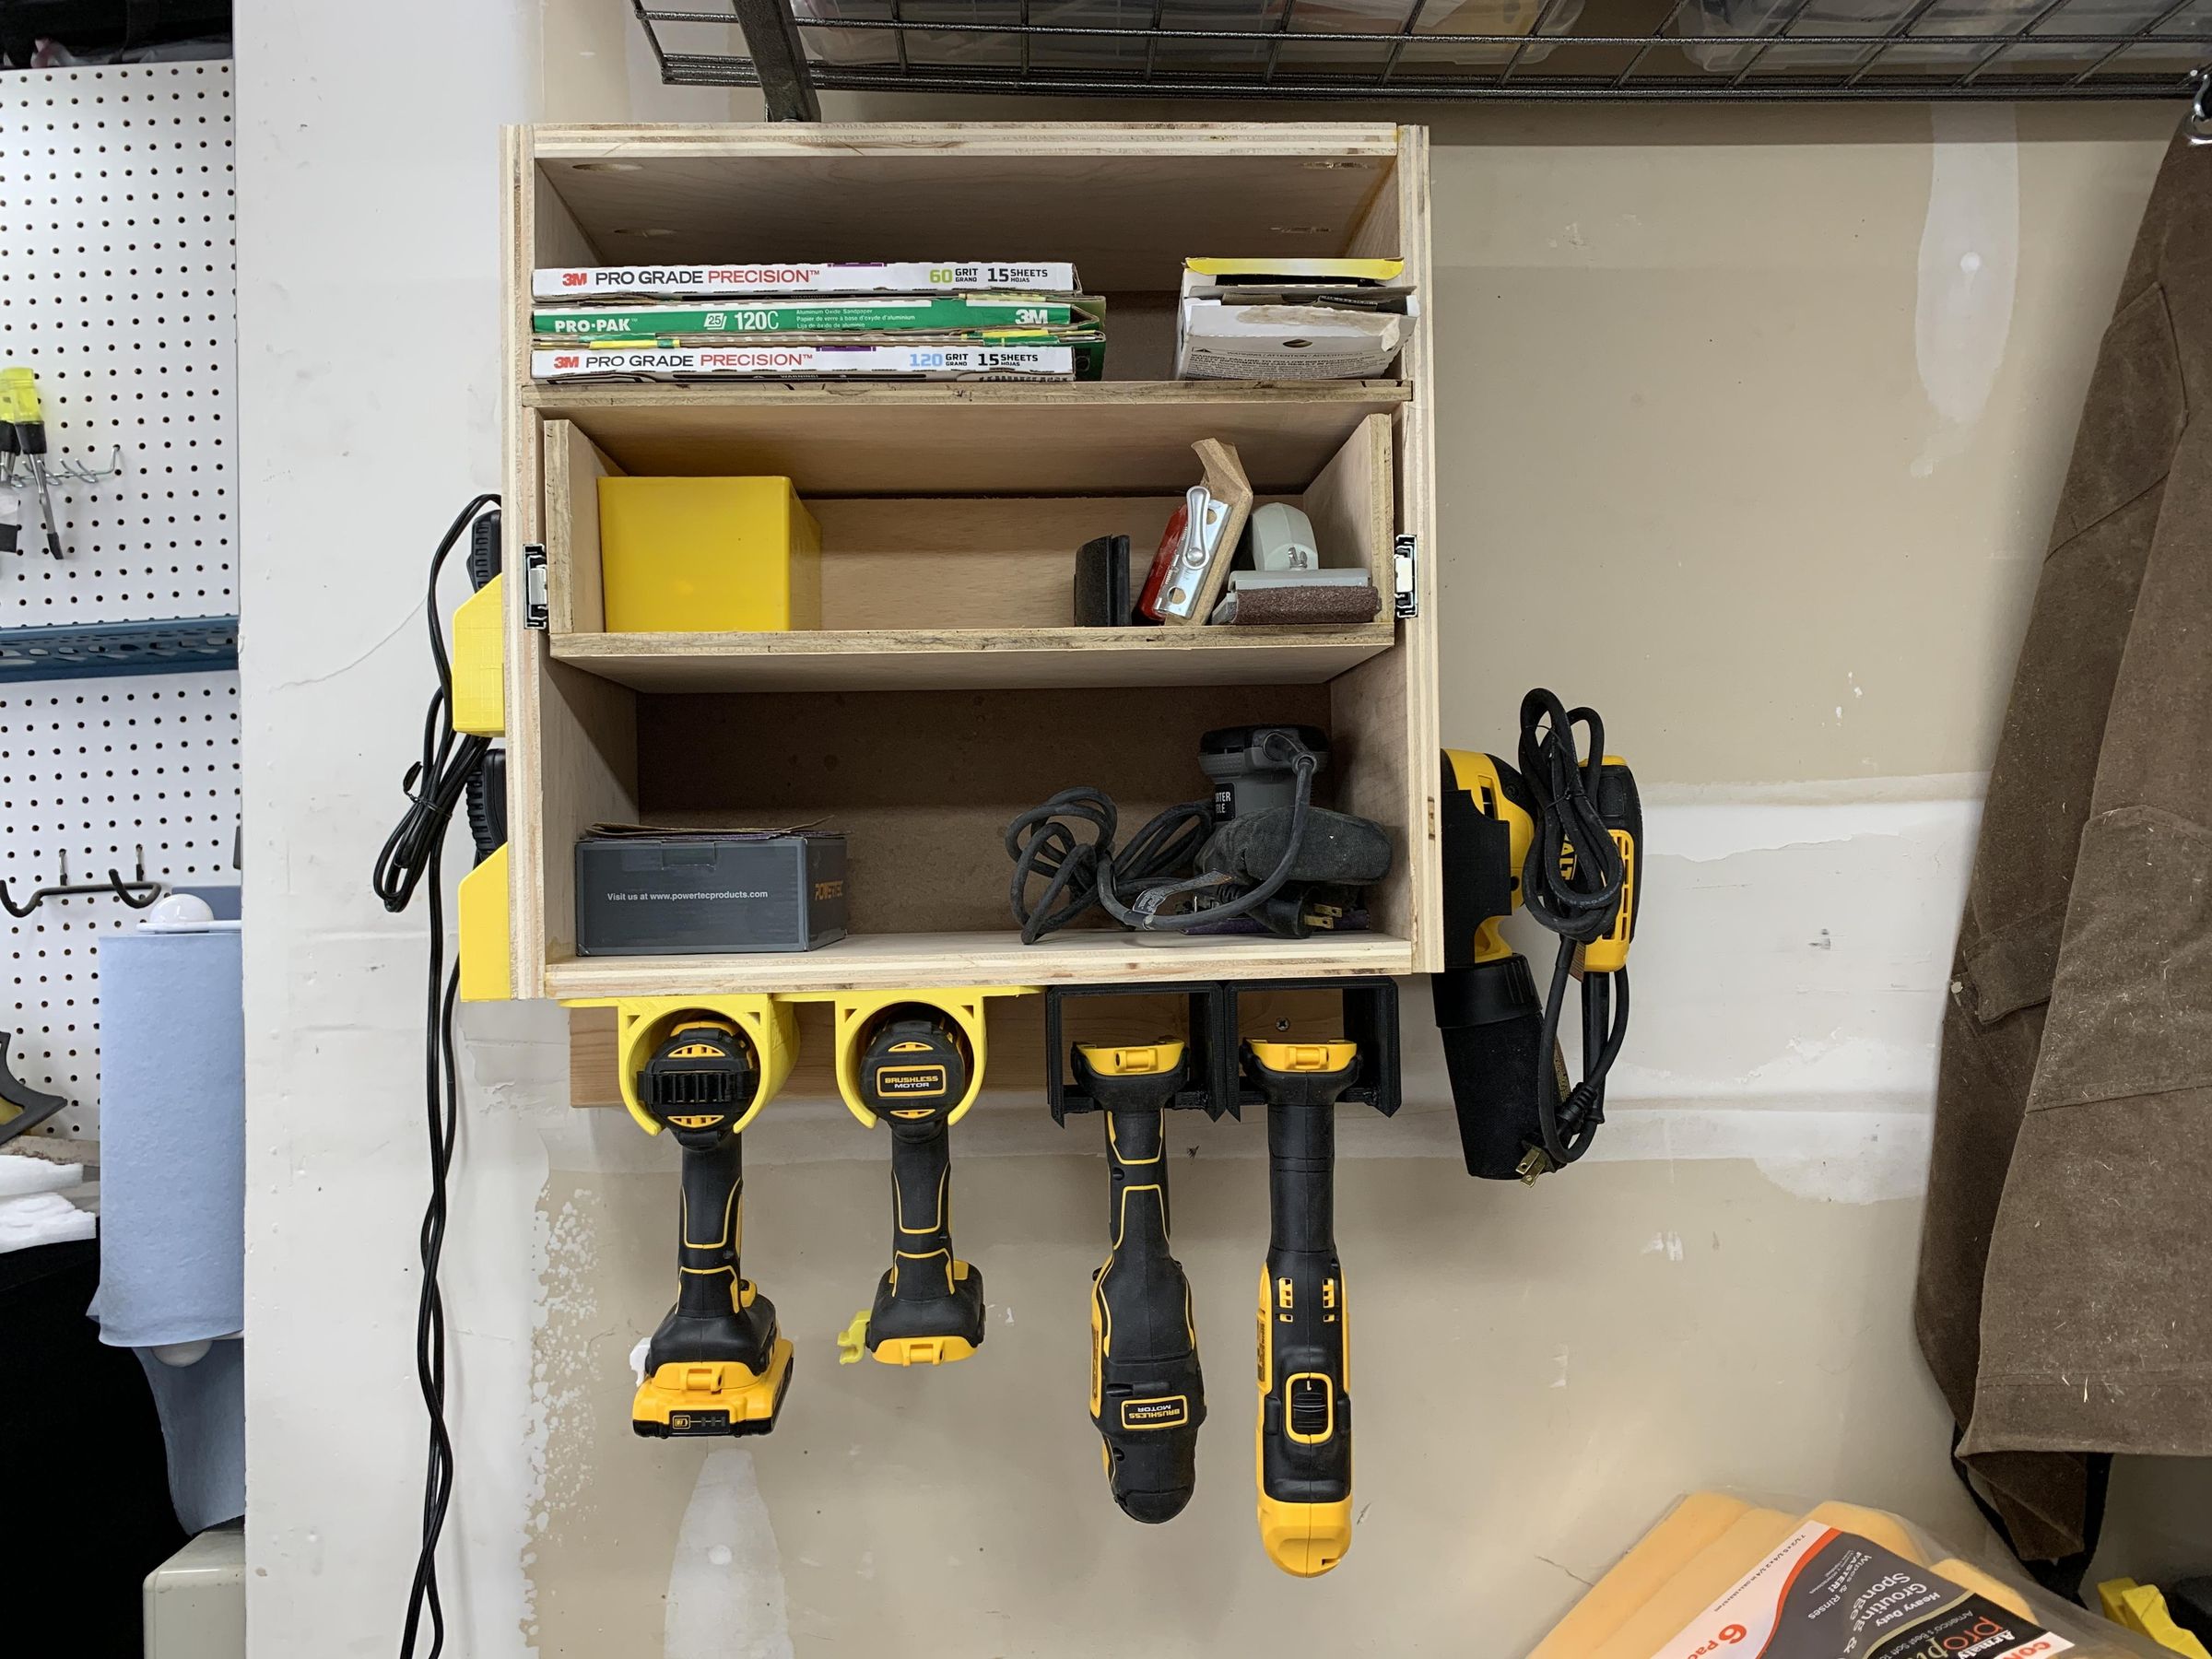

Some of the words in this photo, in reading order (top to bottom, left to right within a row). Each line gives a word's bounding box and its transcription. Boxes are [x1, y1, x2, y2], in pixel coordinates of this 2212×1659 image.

[562, 273, 587, 286] 3M
[595, 272, 635, 285] PRO
[639, 271, 703, 285] GRADE
[929, 269, 953, 284] 60
[955, 268, 979, 276] GRIT
[987, 267, 1009, 282] 15
[1010, 268, 1048, 277] SHEETS
[708, 314, 722, 325] 25
[735, 311, 779, 330] 120C
[1015, 309, 1049, 324] 3M
[554, 356, 579, 369] 3M
[586, 356, 625, 368] PRO
[629, 355, 694, 367] GRADE
[909, 353, 943, 367] 120
[946, 353, 969, 361] GRIT
[978, 353, 1000, 366] 15
[1000, 354, 1038, 362] SHEETS
[607, 892, 626, 900] Visit
[650, 890, 768, 901] www.powertecproducts.com
[885, 1076, 939, 1084] BRUSHLESS
[1128, 1408, 1180, 1419] BRUSHLESS
[1137, 1404, 1171, 1412] MOTOR
[1828, 1551, 1862, 1594] FASTER!
[1846, 1555, 1873, 1583] Wipes
[1839, 1584, 1848, 1594] &
[1850, 1572, 1911, 1620] Sponge
[1807, 1594, 1841, 1619] Rinses
[1853, 1583, 1927, 1633] Grouting
[1903, 1592, 1941, 1612] Heavy
[1876, 1609, 1904, 1627] Duty
[1718, 1623, 1747, 1644] 6
[1843, 1636, 1858, 1654] &
[1958, 1630, 2016, 1659] Armaly
